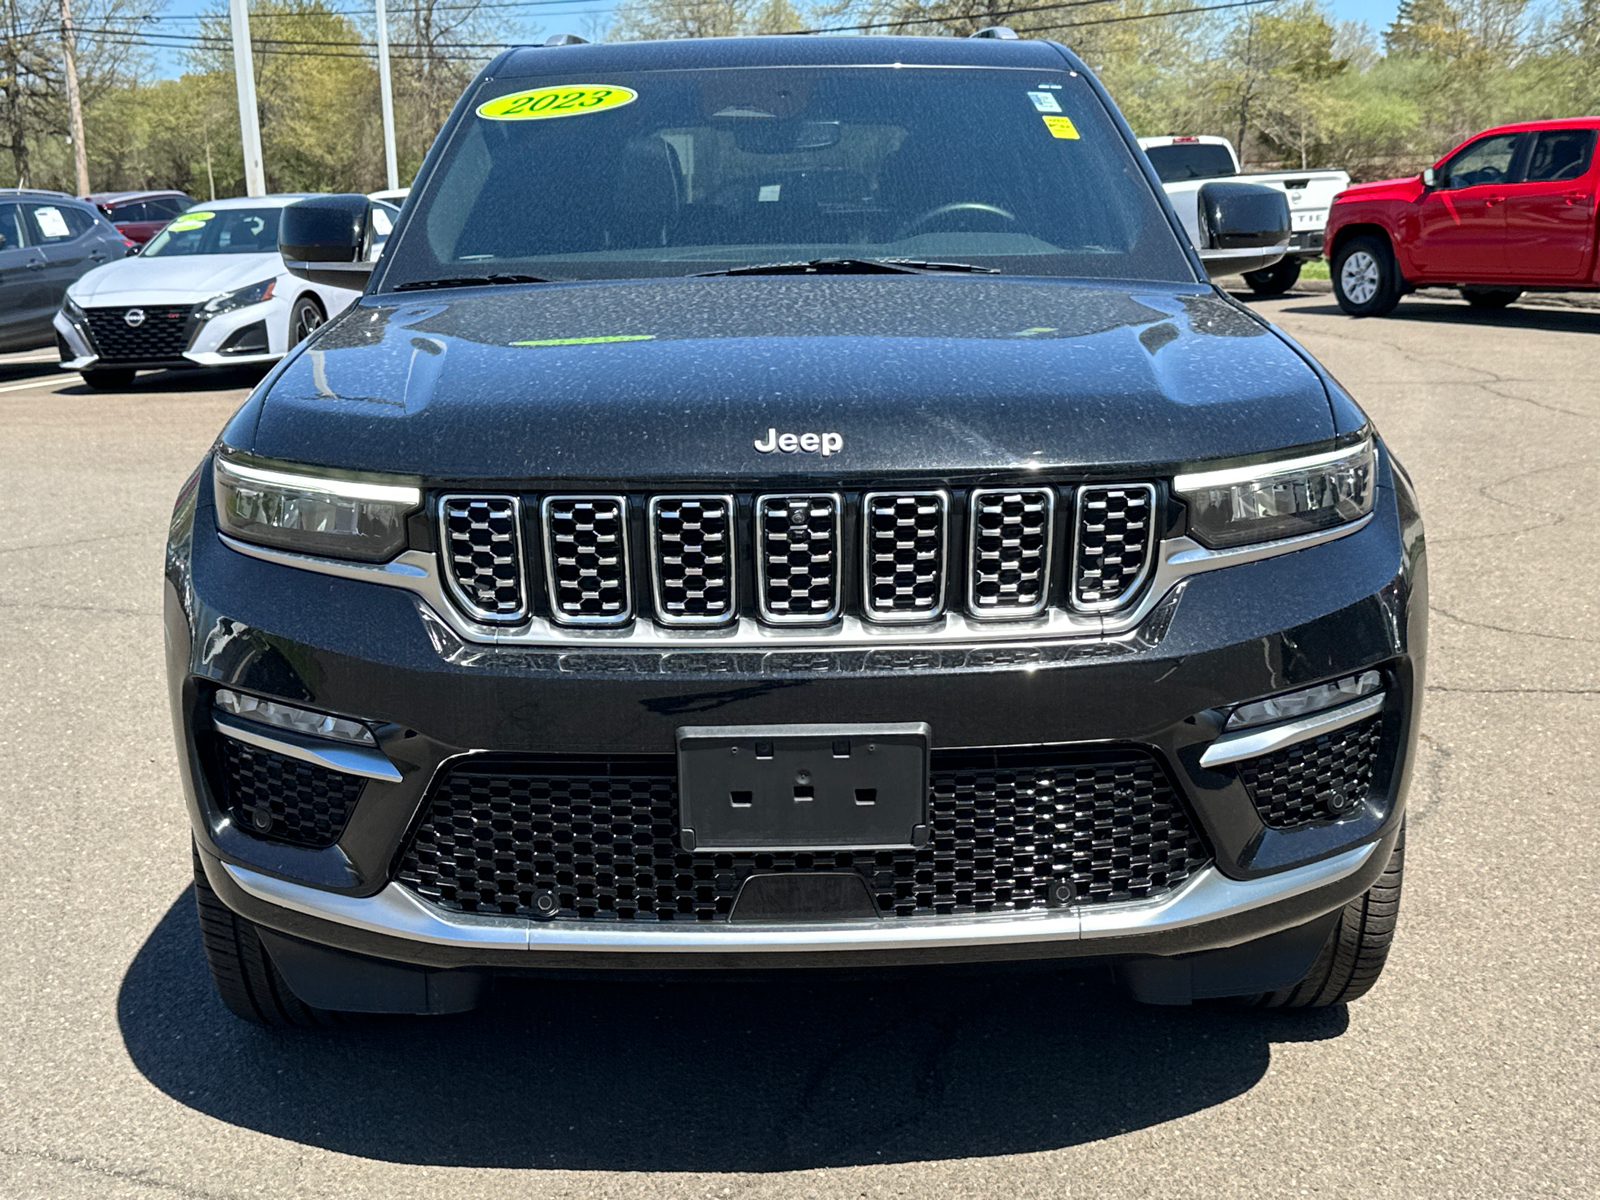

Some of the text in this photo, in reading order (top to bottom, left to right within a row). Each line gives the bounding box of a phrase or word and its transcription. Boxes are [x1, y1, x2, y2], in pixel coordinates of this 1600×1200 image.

[500, 90, 612, 115] 2023
[1297, 214, 1323, 222] TIE
[754, 428, 843, 457] Jeep
